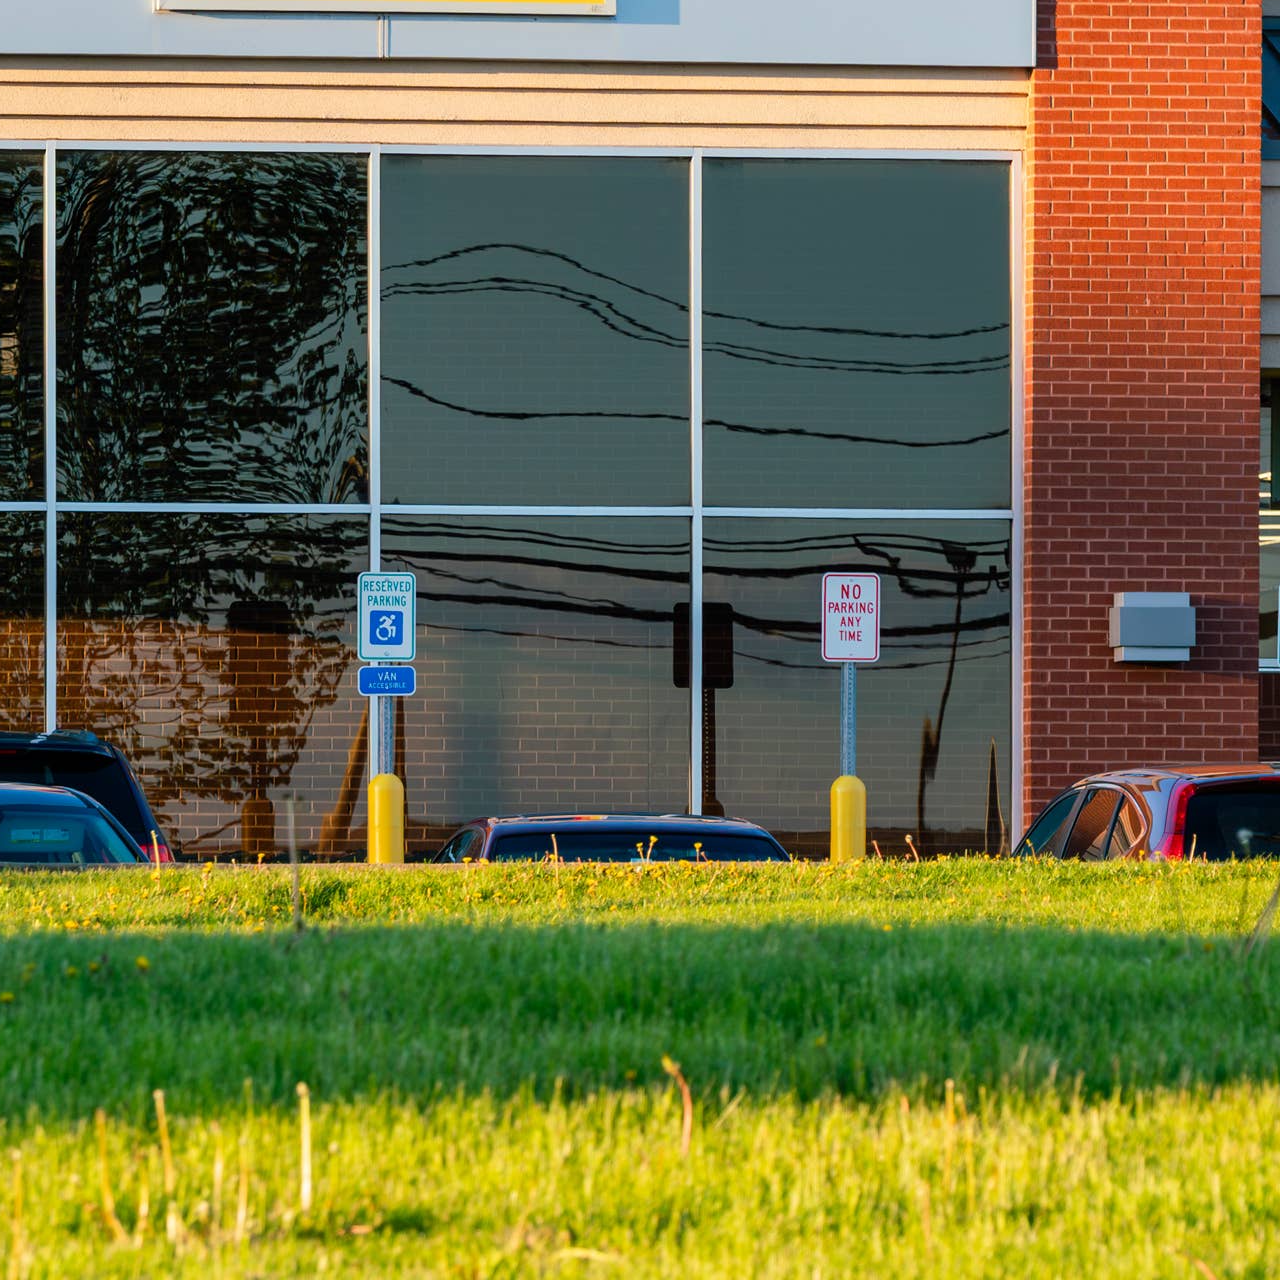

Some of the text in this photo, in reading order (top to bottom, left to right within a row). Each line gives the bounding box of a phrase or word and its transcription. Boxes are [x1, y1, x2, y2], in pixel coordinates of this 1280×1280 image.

[363, 580, 411, 592] RESERVED
[841, 584, 861, 600] NO
[367, 595, 407, 607] PARKING
[828, 602, 874, 614] PARKING
[840, 616, 862, 627] ANY
[839, 630, 862, 641] TIME
[377, 672, 397, 681] VAN
